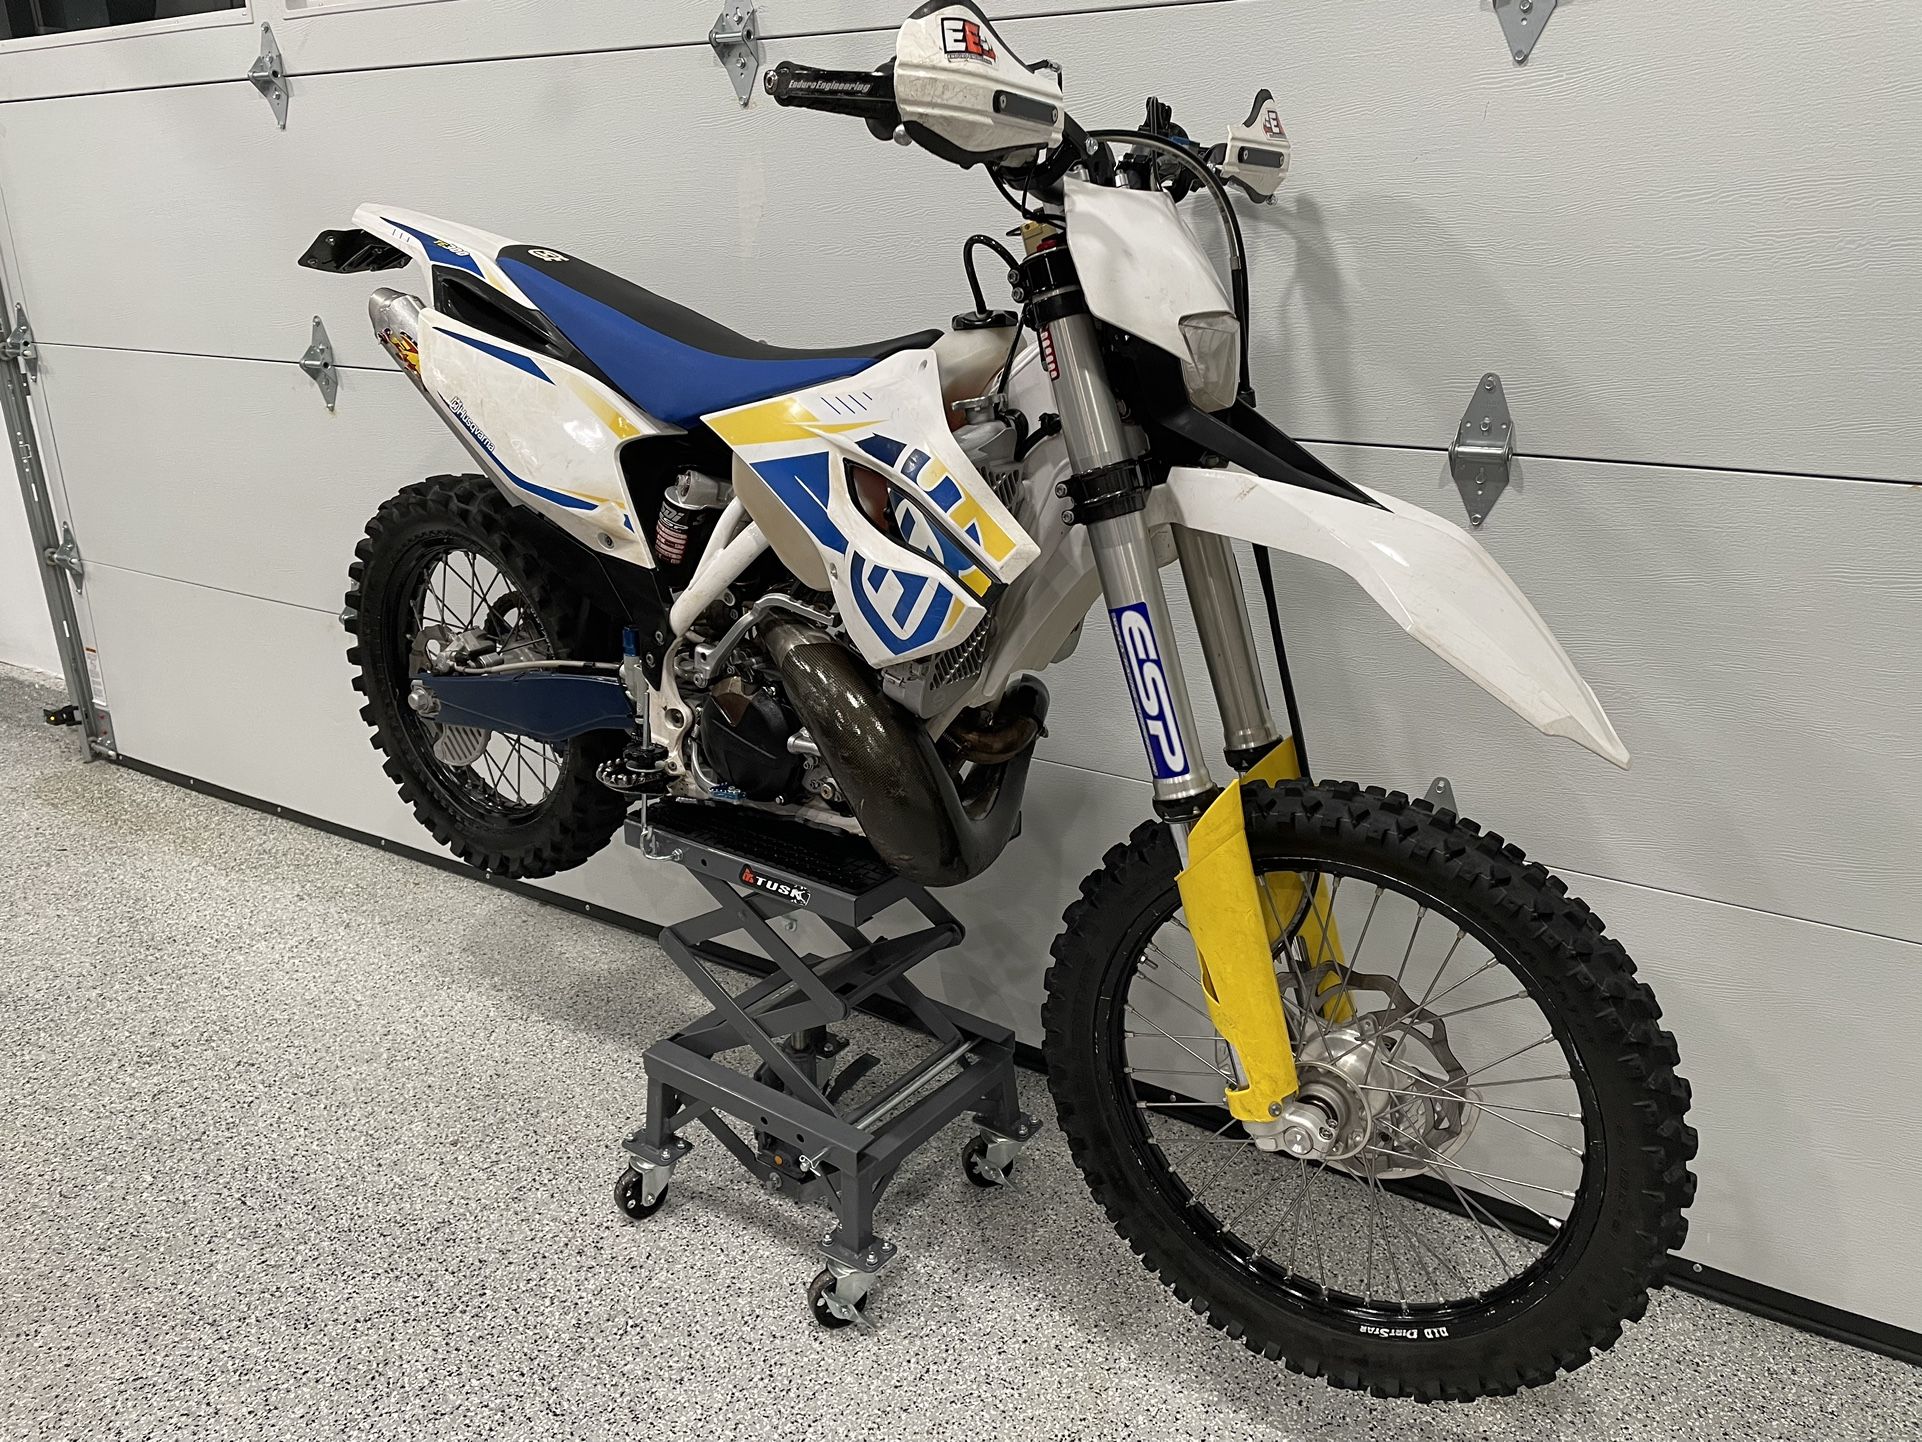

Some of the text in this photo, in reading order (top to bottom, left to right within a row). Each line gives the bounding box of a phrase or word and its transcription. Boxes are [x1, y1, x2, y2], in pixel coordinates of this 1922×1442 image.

[788, 80, 871, 93] Enduro Engineering
[456, 404, 496, 452] Husqvarna
[1121, 610, 1185, 772] ESP
[756, 876, 806, 905] TUSK
